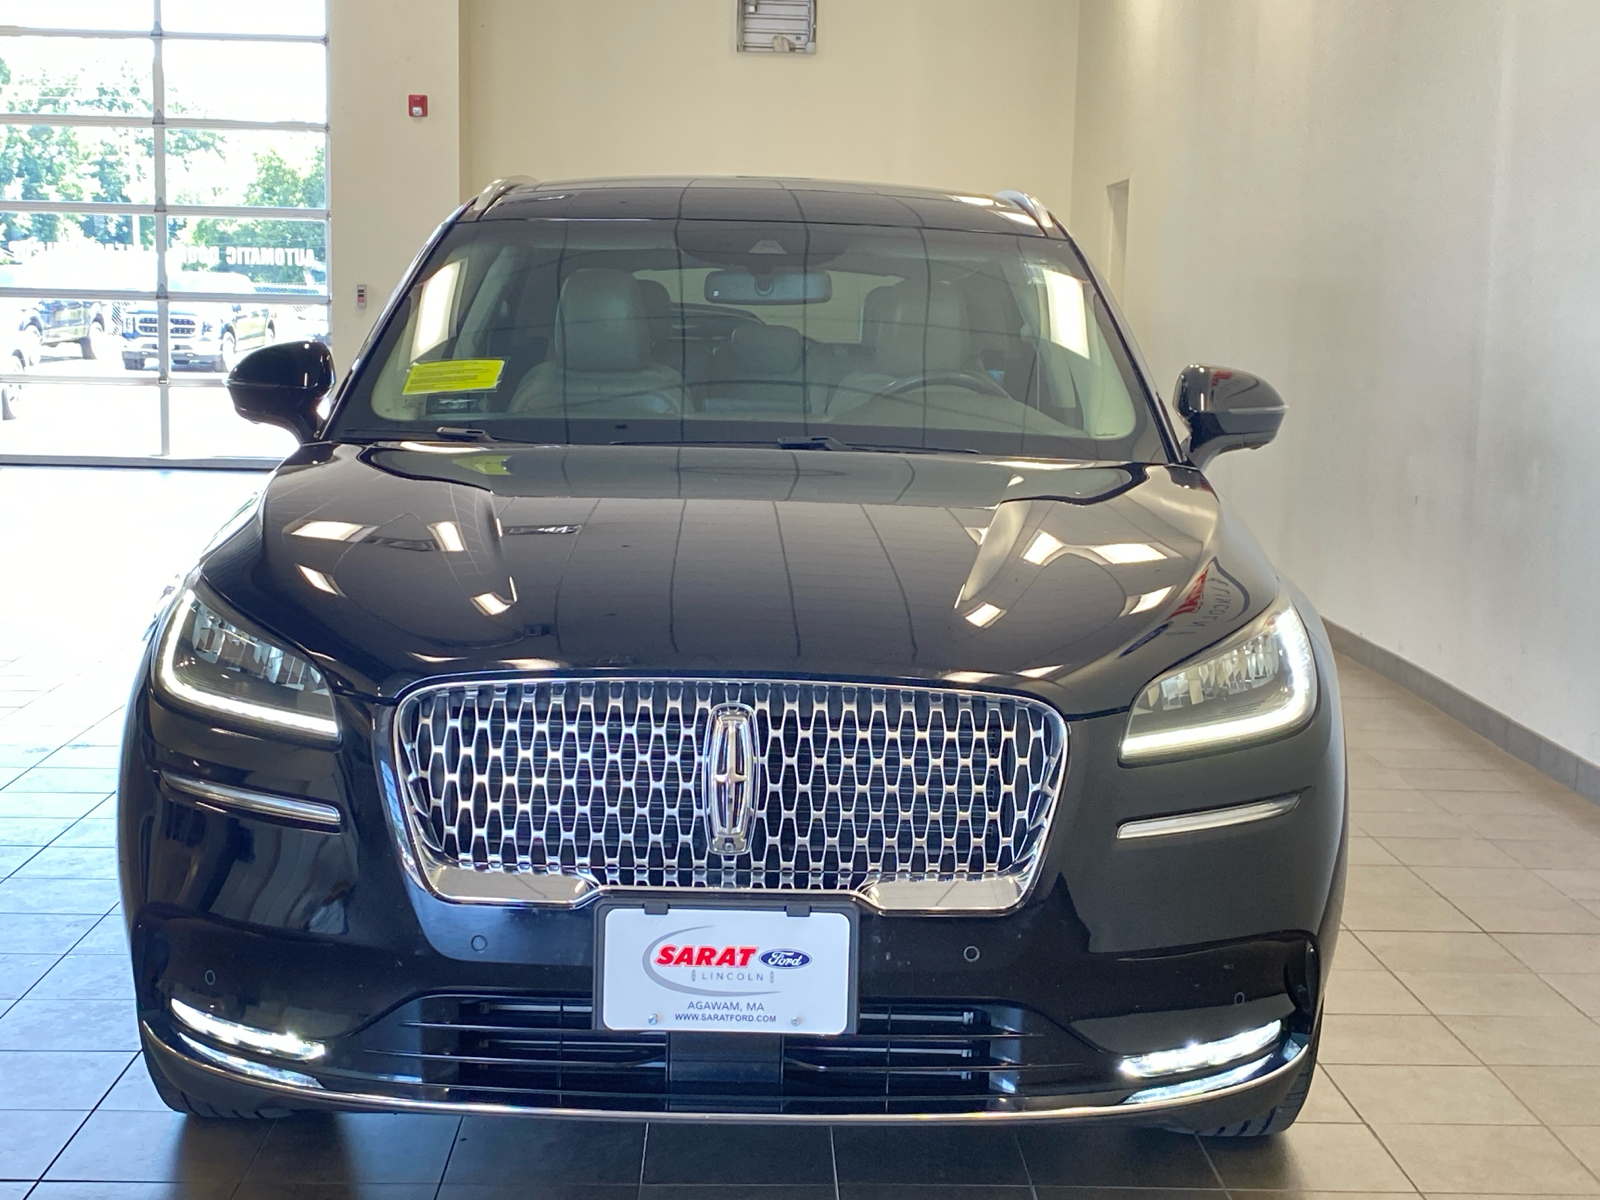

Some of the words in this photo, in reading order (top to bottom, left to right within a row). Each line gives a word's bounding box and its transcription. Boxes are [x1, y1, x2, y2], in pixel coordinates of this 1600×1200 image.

[655, 945, 758, 967] SARAT
[767, 951, 802, 966] Ford
[701, 972, 764, 982] LINCOLN
[687, 1001, 743, 1012] AGAWAM,
[746, 1002, 765, 1012] MA
[674, 1013, 777, 1023] WWW.SARATFORD.COM
